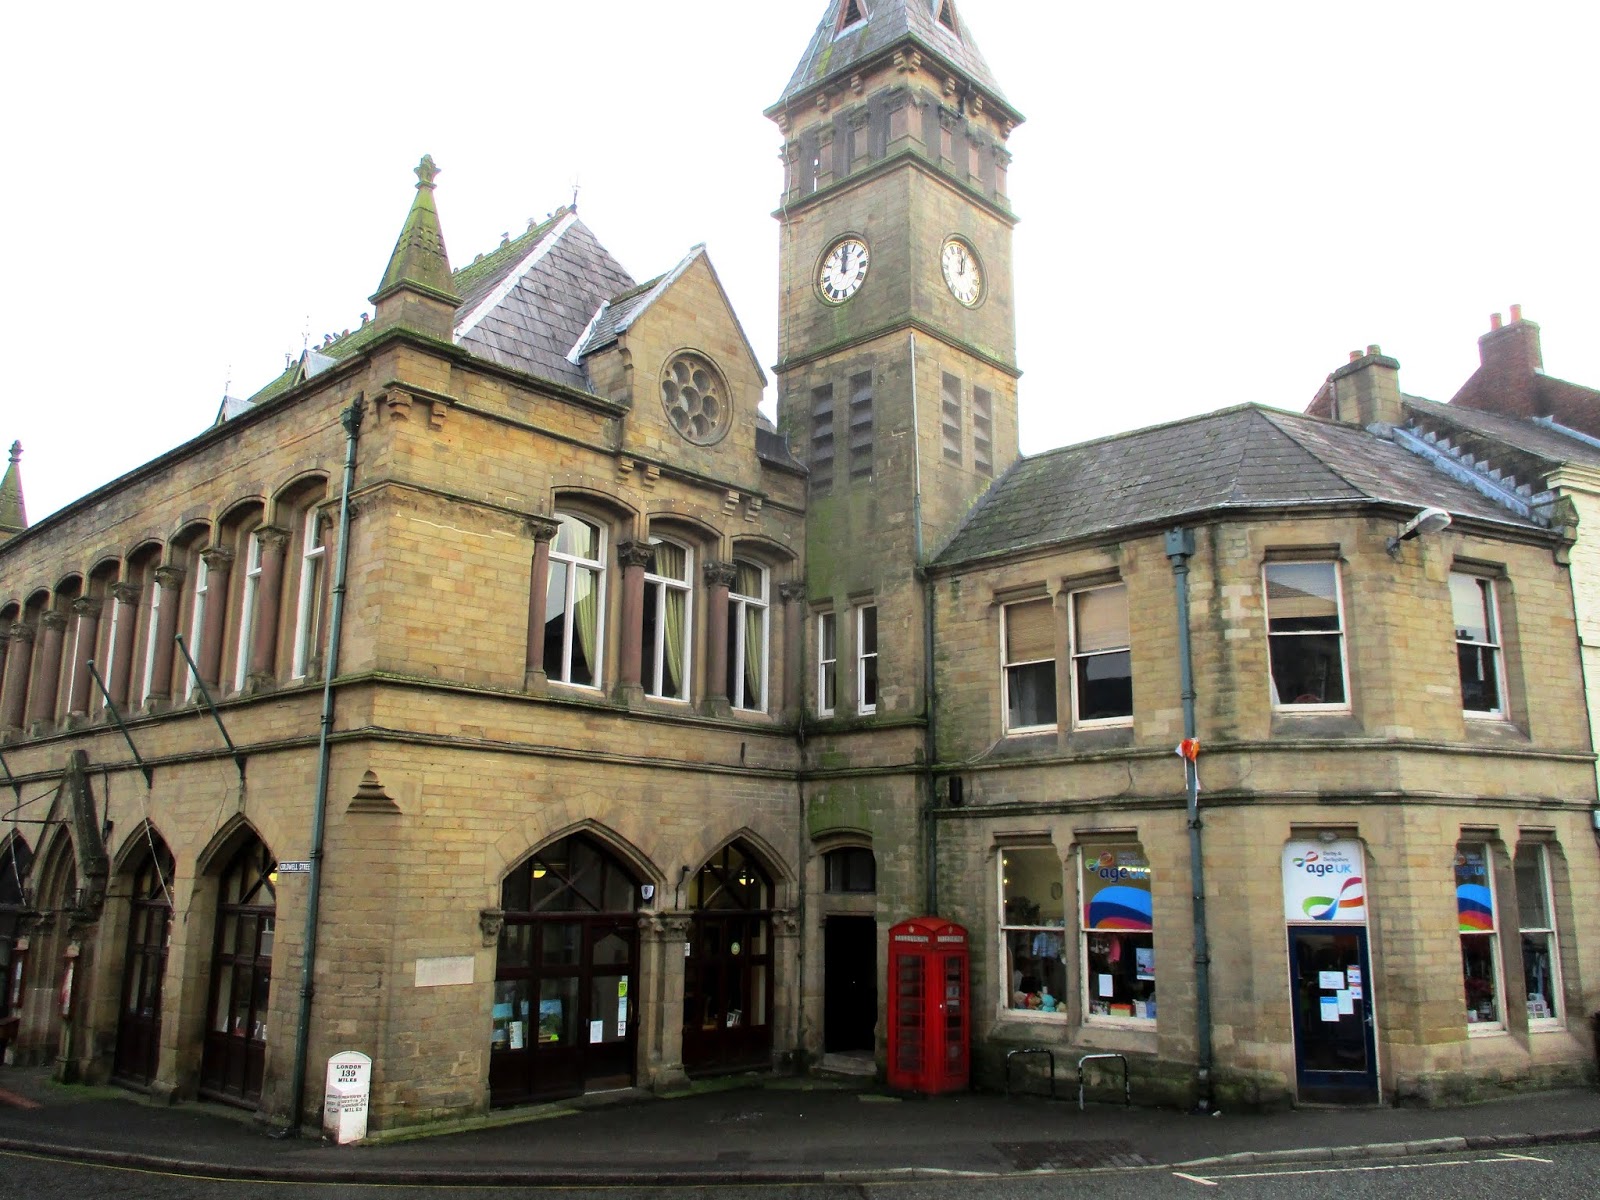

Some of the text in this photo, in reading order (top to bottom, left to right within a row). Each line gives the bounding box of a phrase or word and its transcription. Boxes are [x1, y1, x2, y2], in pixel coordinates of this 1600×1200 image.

[299, 862, 311, 871] STREE
[1306, 864, 1352, 877] age UK
[1099, 867, 1128, 883] age
[341, 1069, 356, 1077] 139
